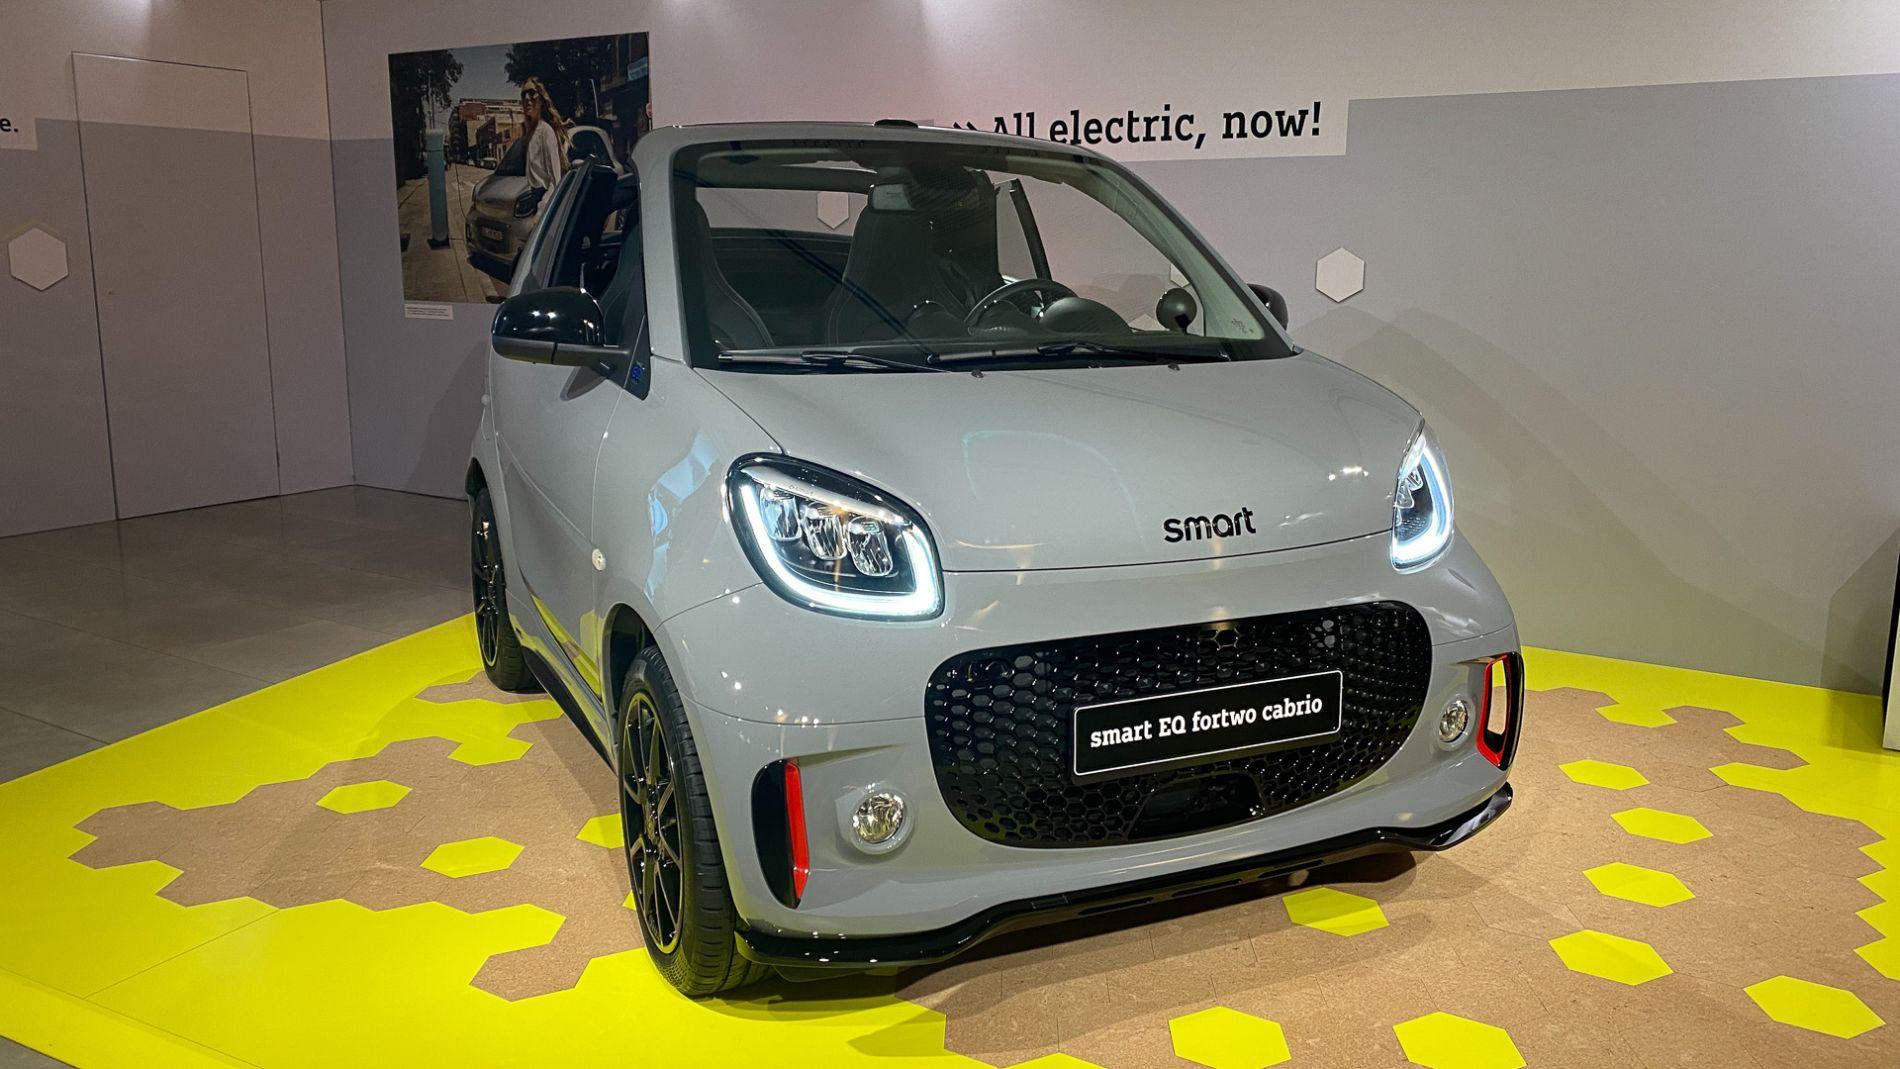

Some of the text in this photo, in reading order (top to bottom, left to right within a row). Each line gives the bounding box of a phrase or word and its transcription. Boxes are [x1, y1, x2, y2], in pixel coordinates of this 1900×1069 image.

[1050, 104, 1206, 150] electric,
[1222, 101, 1321, 139] now!
[1163, 507, 1257, 543] smart
[1090, 694, 1323, 748] smart EQ fortwo cabrio
